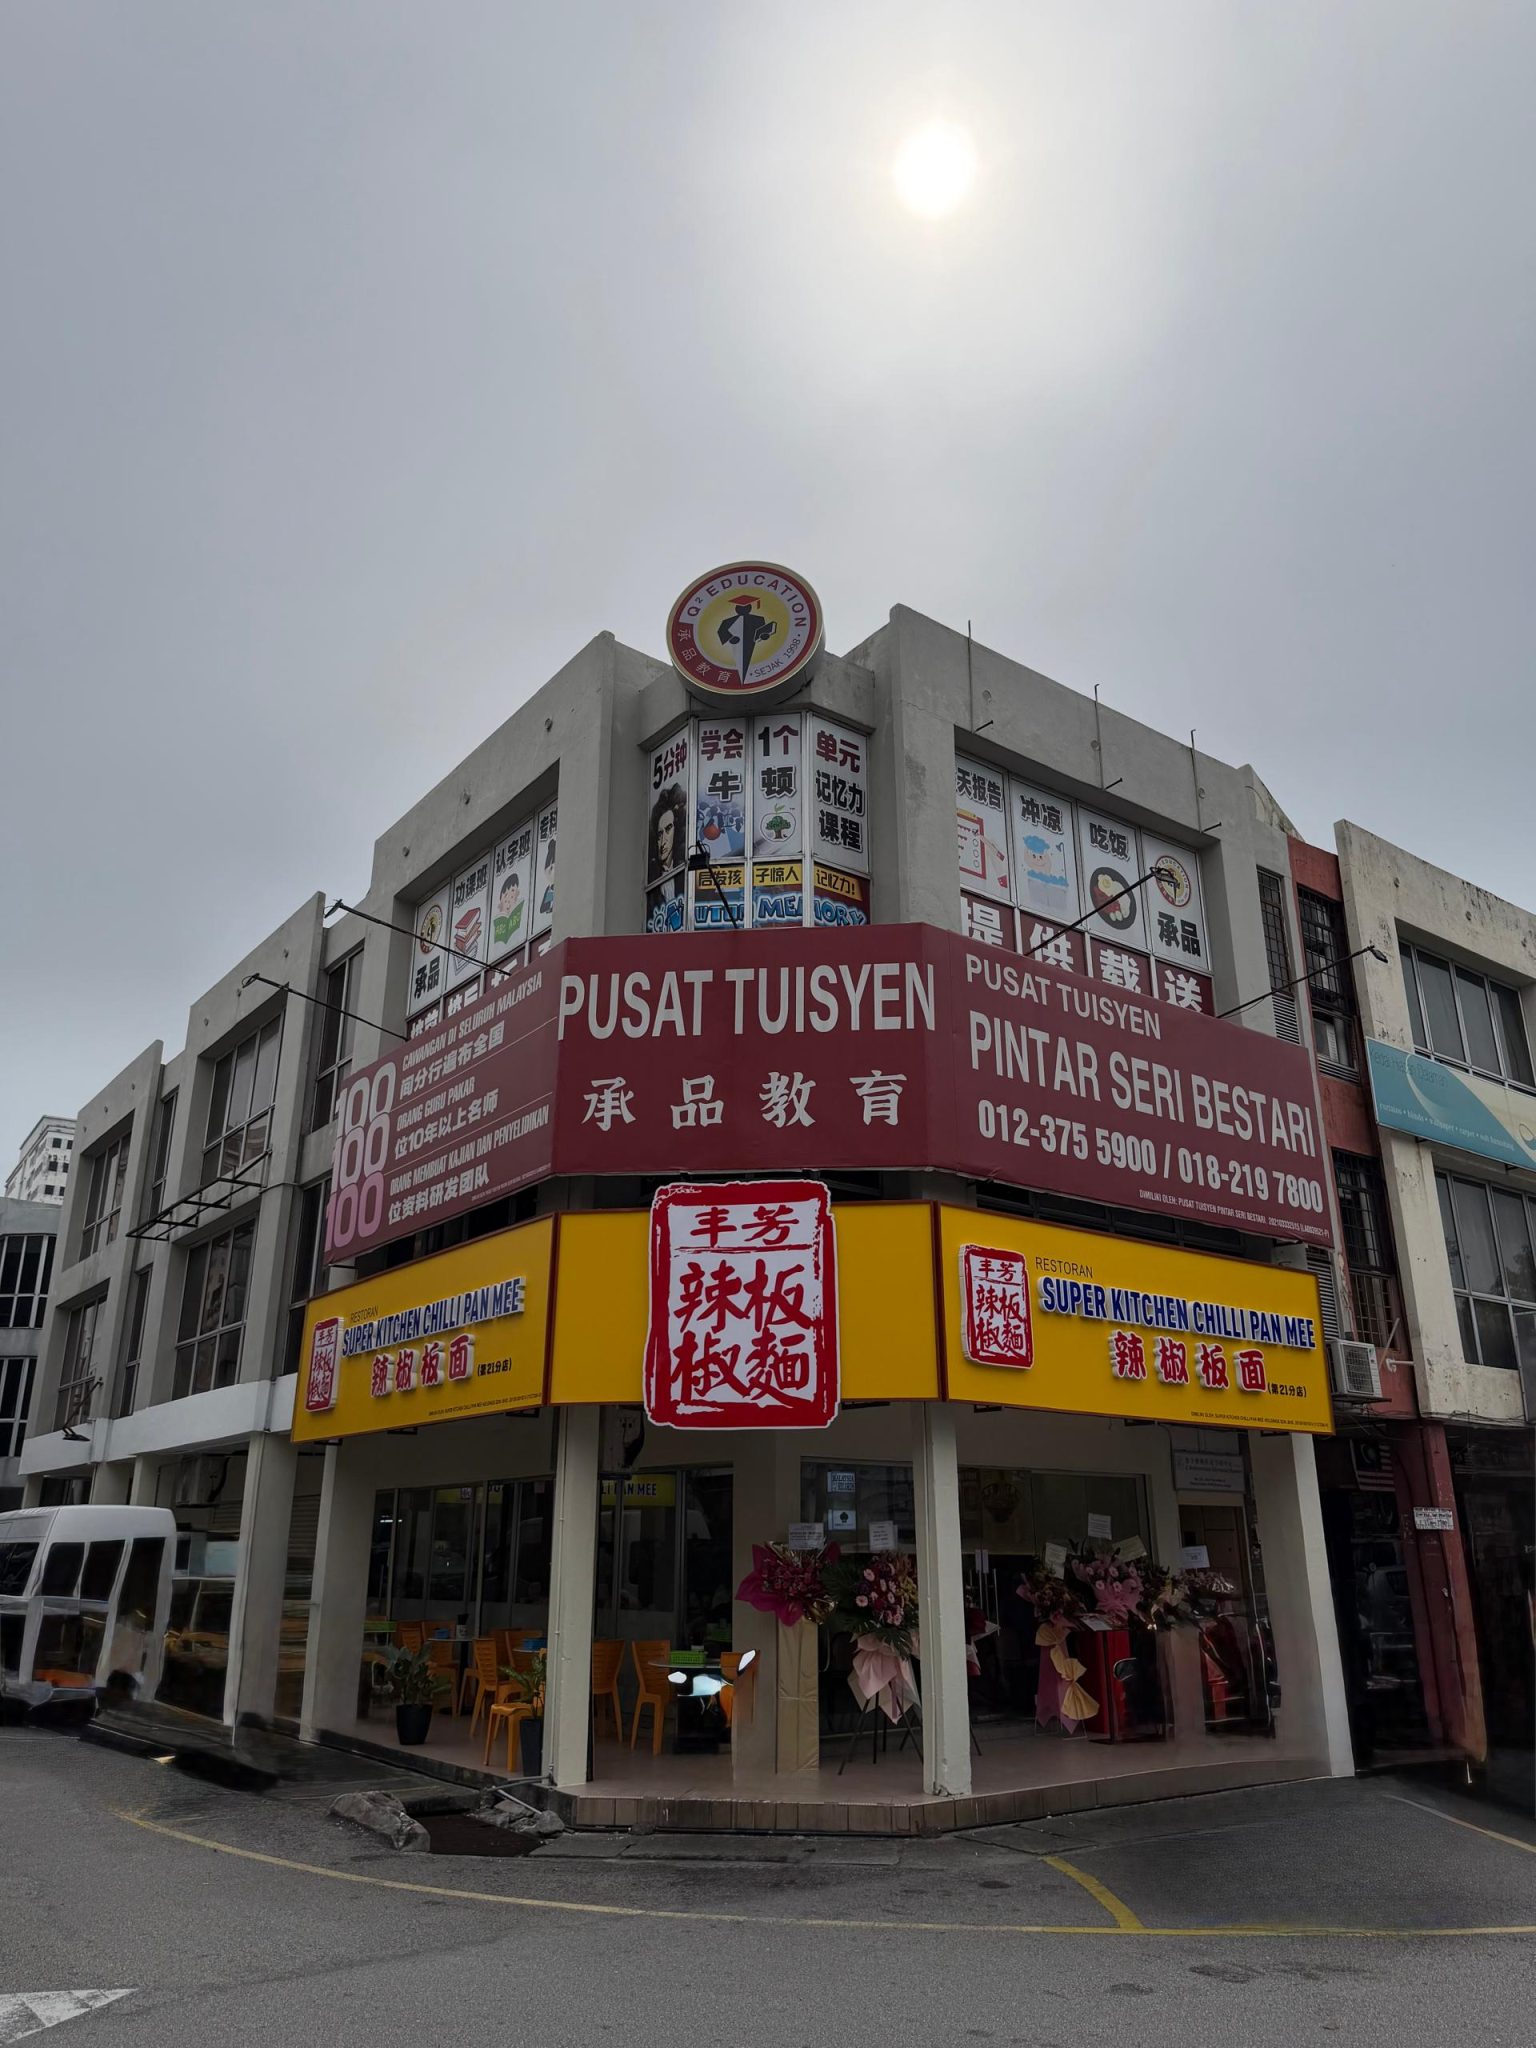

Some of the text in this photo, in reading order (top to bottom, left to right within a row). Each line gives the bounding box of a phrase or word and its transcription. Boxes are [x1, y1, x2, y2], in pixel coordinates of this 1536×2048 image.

[706, 574, 807, 628] EDUCATION
[678, 629, 732, 683] 承品教育
[754, 638, 802, 678] SEJAK 1998
[653, 724, 862, 790] 5分钟 学会 1个 单元
[707, 766, 864, 817] 牛 顿 记忆力
[1020, 796, 1063, 834] 冲凉
[819, 810, 863, 853] 课程
[1089, 823, 1130, 861] 吃饭
[755, 865, 800, 884] 子惊人
[1157, 911, 1201, 957] 承品
[414, 955, 440, 999] 承品
[966, 954, 1161, 1040] PUSAT TUISYEN
[1029, 922, 1074, 972] 供
[1099, 949, 1142, 994] 载
[1164, 969, 1203, 1013] 送
[402, 1034, 447, 1071] CAWANGAN
[447, 1026, 457, 1047] DI
[459, 1004, 494, 1042] SELURUH
[496, 971, 542, 1015] MALAYSIA
[558, 969, 713, 1040] PUSAT
[725, 962, 936, 1034] TUISYEN
[334, 1062, 397, 1138] 100
[397, 1077, 475, 1131] ORANG GURU PAKAR
[582, 1070, 908, 1131] 承品教育
[969, 1010, 1316, 1157] PINTAR SERI BESTARI
[331, 1112, 391, 1194] 100
[390, 1171, 412, 1196] ORANG
[413, 1154, 446, 1191] MEMBUAT
[448, 1141, 475, 1170] KAJIAN
[476, 1134, 492, 1157] DAN
[493, 1104, 549, 1149] PENYELIDIKAN
[395, 1088, 499, 1160] 位10年以上名师
[978, 1099, 1324, 1214] 012-375 5900 / 018-219 7800
[324, 1170, 384, 1253] 100
[1178, 1195, 1195, 1208] PUSAT
[1035, 1256, 1093, 1279] RESTORAN
[342, 1277, 524, 1356] SUPER KITCHEN CHILLI PAN MEE
[351, 1306, 379, 1323] RESTORAN
[1042, 1277, 1315, 1348] SUPER KITCHEN CHILLI PAN MEE
[370, 1333, 472, 1398] 辣椒板面
[1113, 1330, 1267, 1393] 辣椒板面
